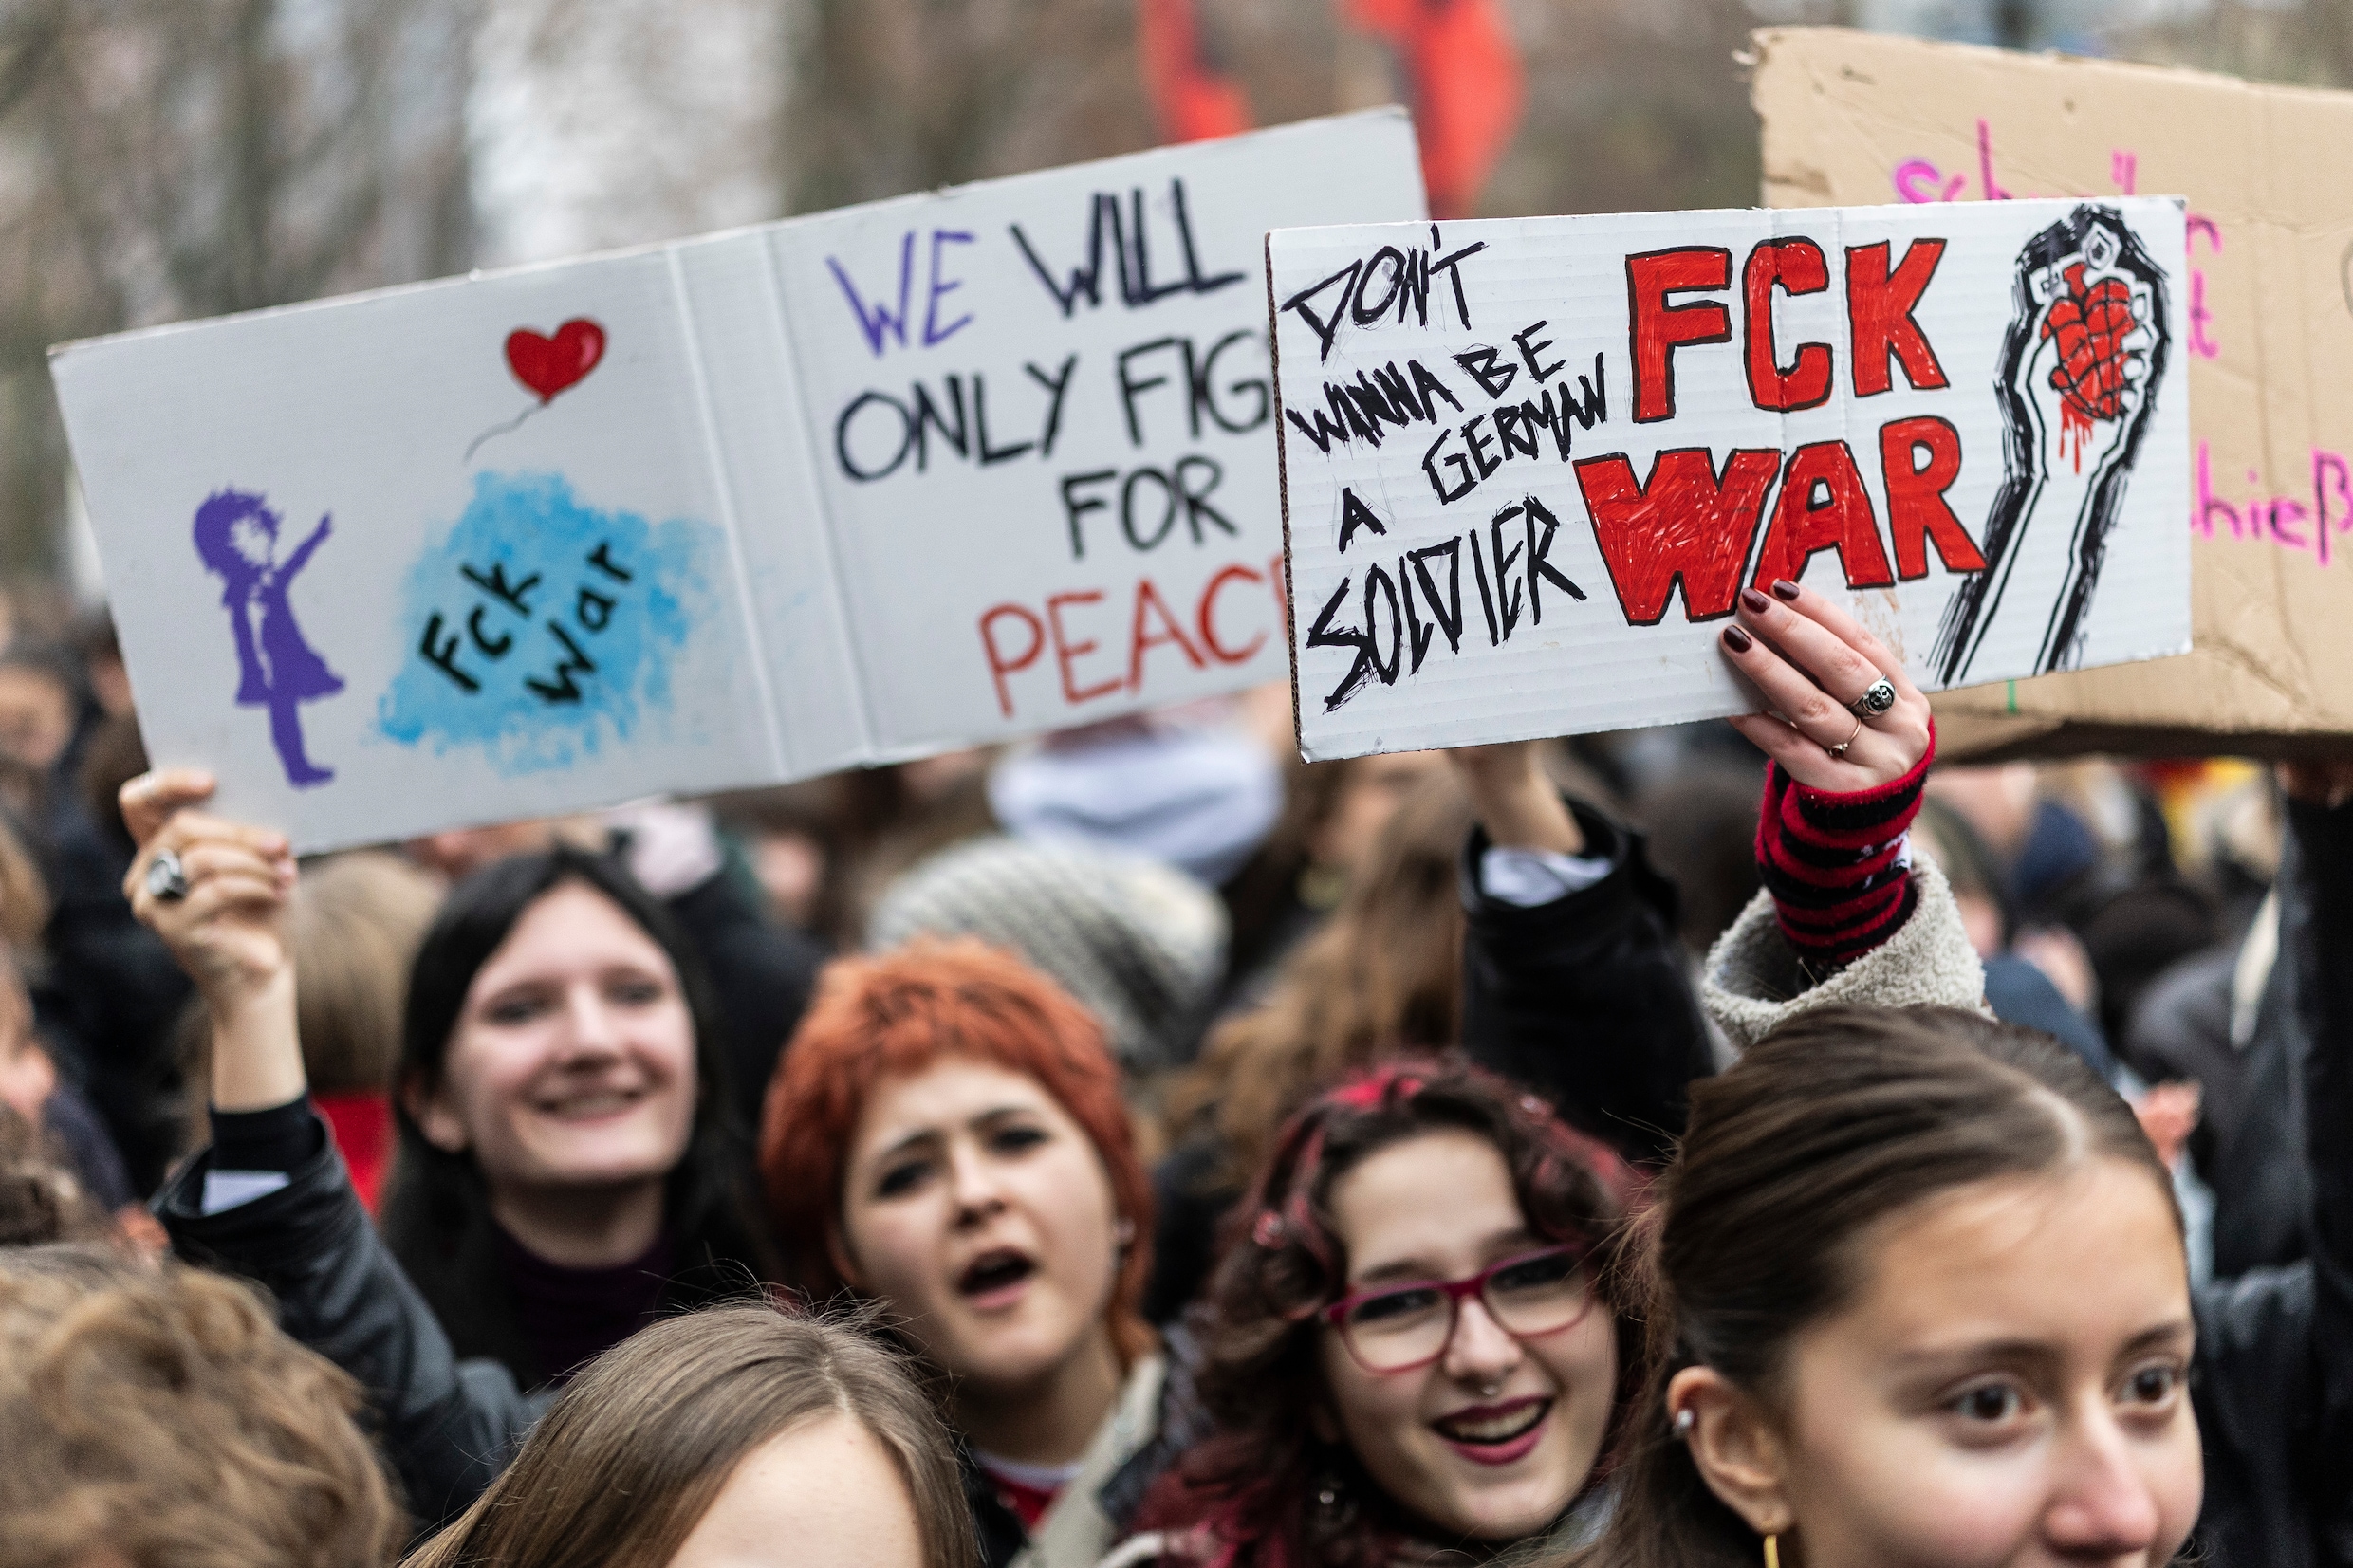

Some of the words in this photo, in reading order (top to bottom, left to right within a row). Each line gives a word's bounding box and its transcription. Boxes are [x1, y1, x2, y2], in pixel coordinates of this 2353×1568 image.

[825, 230, 976, 358] WE
[1010, 178, 1246, 318] WILL
[1279, 223, 1488, 362] DON'T
[1625, 236, 1950, 423] FCK
[835, 354, 1078, 482] ONLY
[1115, 328, 1270, 449] FIG
[1285, 359, 1465, 454] WANNA
[1454, 321, 1566, 398] BE
[1338, 486, 1387, 553] A
[1422, 353, 1607, 504] GERMAN
[1059, 455, 1240, 560] FOR
[1572, 415, 1989, 626] WAR
[2191, 438, 2353, 569] hieß
[1306, 494, 1587, 714] SOLDIER
